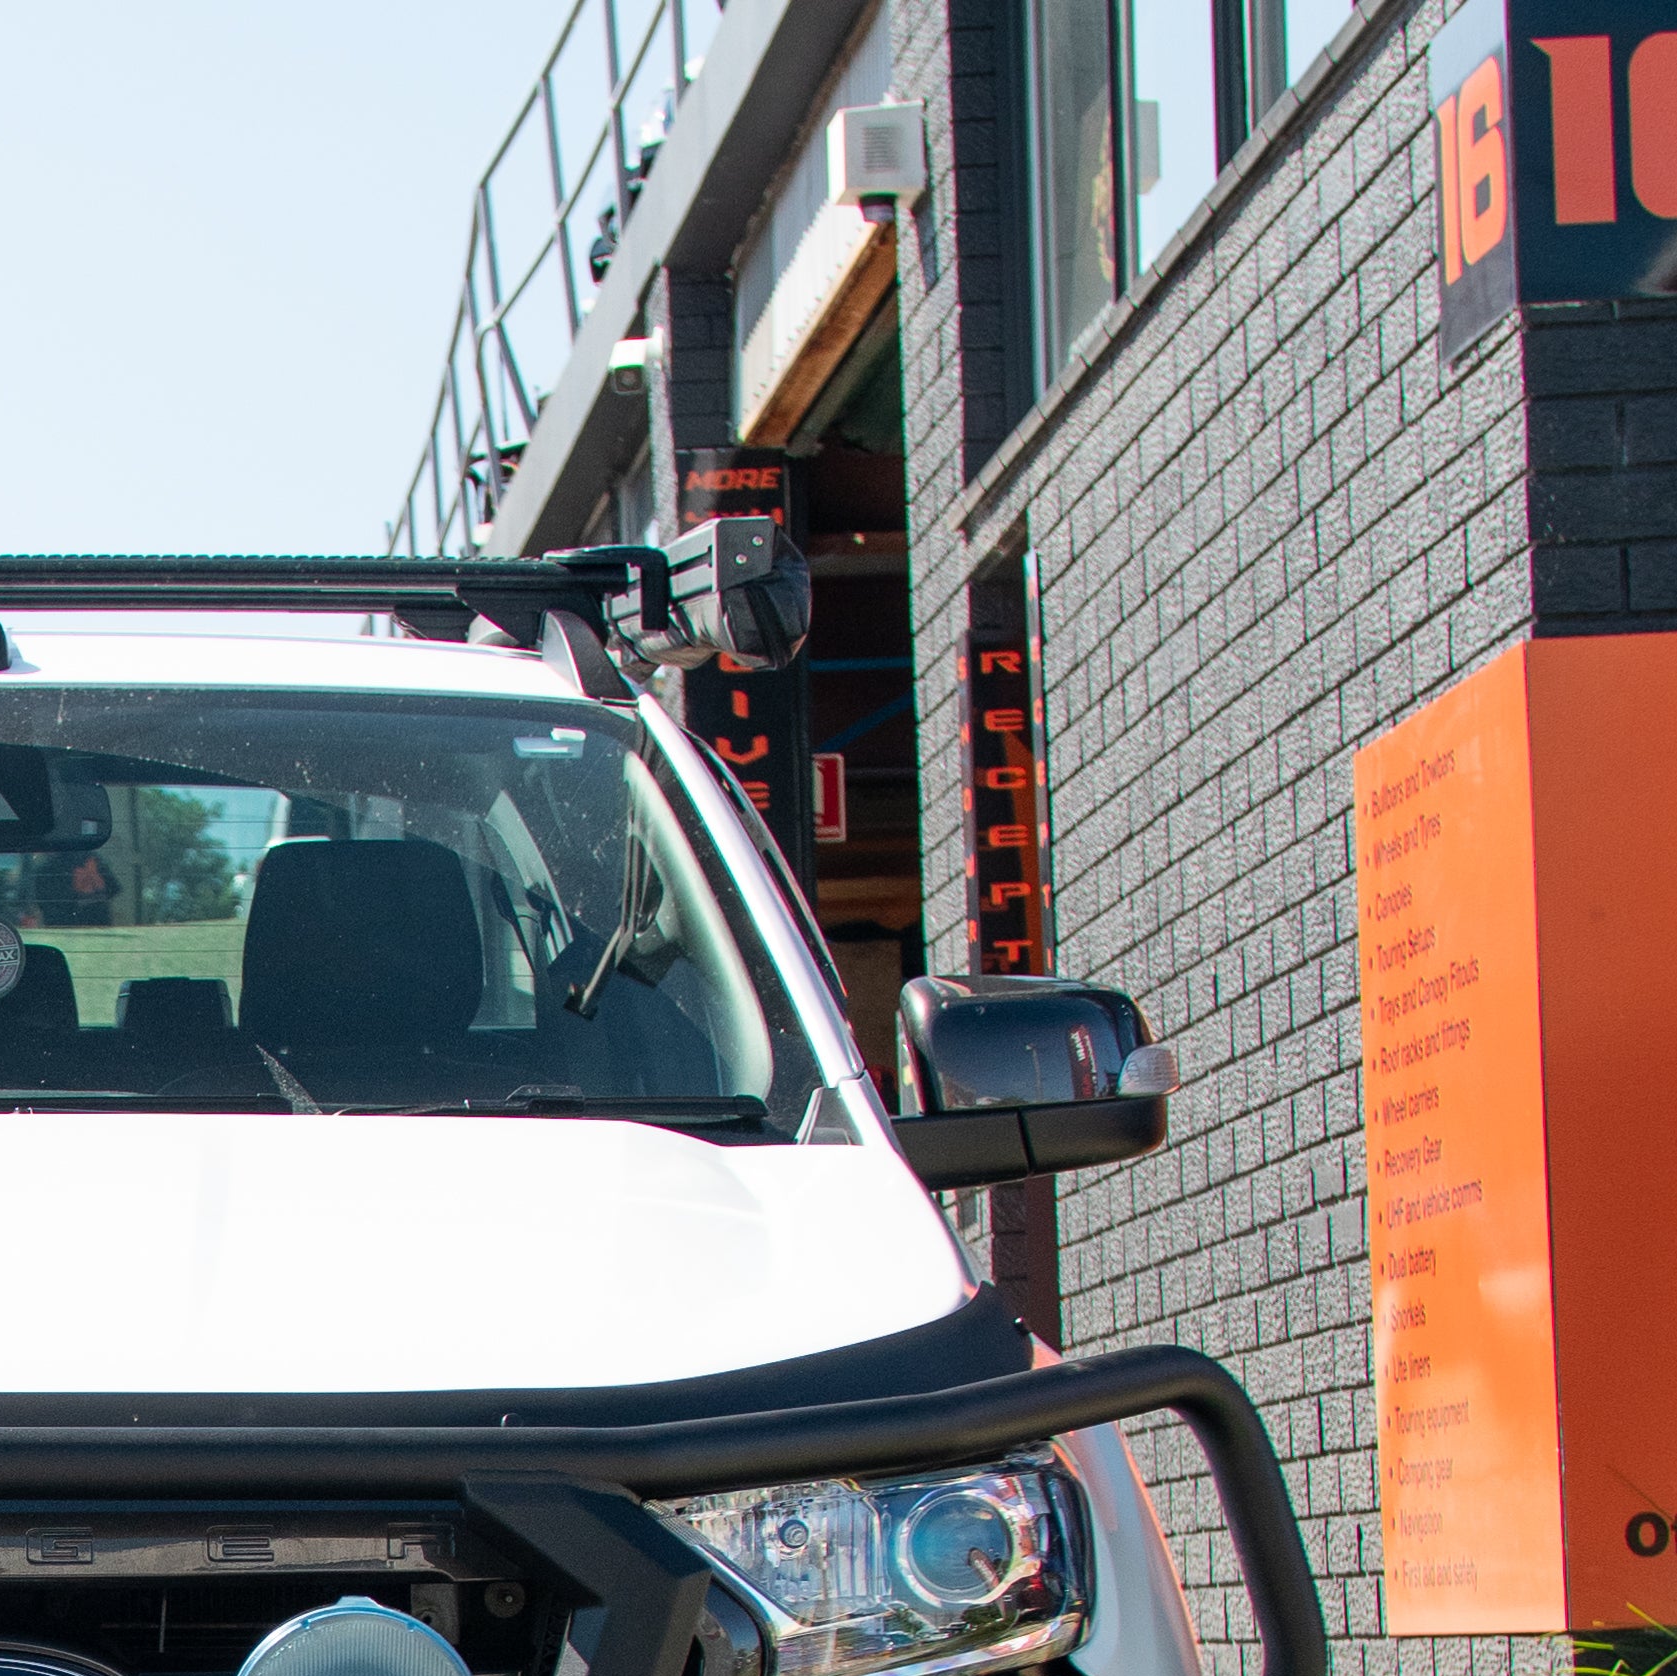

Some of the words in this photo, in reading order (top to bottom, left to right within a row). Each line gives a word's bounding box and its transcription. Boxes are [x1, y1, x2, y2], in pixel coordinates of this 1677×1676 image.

[1437, 55, 1508, 286] 16
[686, 466, 782, 491] MORE
[980, 651, 1034, 963] RECEPT
[1374, 831, 1402, 870] Wheels
[1404, 819, 1418, 854] and
[1419, 812, 1441, 849] Tyres
[1376, 880, 1412, 921] Canopies
[1377, 938, 1406, 973] Touring
[1379, 995, 1400, 1026] Trays
[1403, 980, 1416, 1014] and
[1381, 1042, 1400, 1075] Roof
[1401, 1035, 1423, 1069] racks
[1425, 1022, 1439, 1058] and
[1382, 1092, 1407, 1126] Wheel
[1385, 1148, 1420, 1178] Recovery
[1387, 1197, 1404, 1229] UHF
[1405, 1191, 1420, 1224] and
[1388, 1249, 1407, 1281] Dual
[1408, 1245, 1436, 1278] battery
[1408, 1351, 1431, 1380] liners
[1395, 1405, 1425, 1438] Touring
